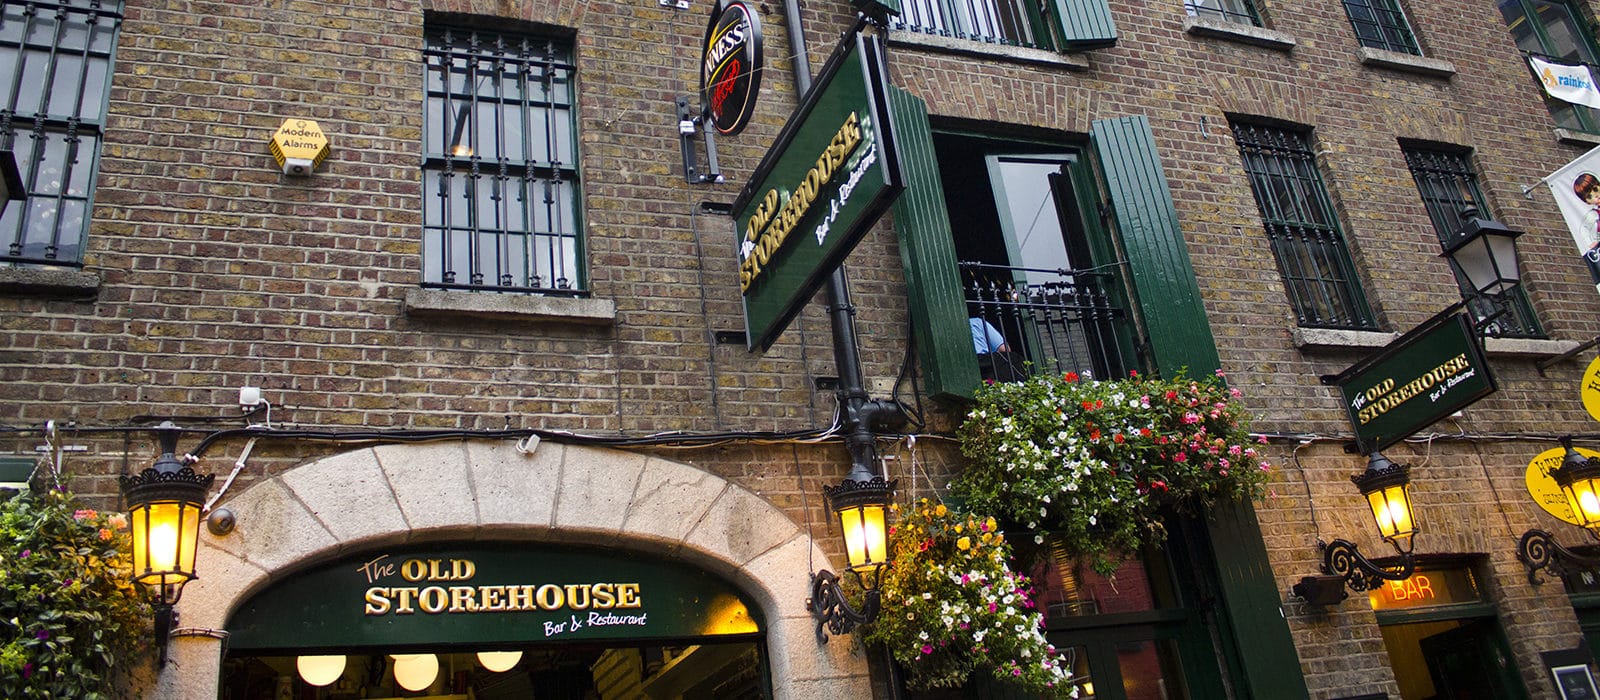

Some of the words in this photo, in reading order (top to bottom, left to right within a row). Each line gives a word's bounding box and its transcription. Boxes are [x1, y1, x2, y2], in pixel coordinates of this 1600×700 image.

[281, 127, 321, 138] Modern
[282, 140, 318, 150] Alarms
[740, 110, 862, 294] STOREHOUSE
[815, 215, 830, 247] Bar
[830, 198, 841, 223] &
[838, 143, 878, 207] Restaurant
[748, 188, 779, 242] OLD
[1351, 391, 1366, 411] The
[1365, 377, 1396, 402] OLD
[1357, 352, 1470, 426] STOREHOUSE
[1429, 389, 1441, 403] Bar
[1446, 367, 1476, 390] Restaurant
[356, 553, 397, 584] The
[401, 558, 477, 582] OLD
[364, 582, 642, 616] STOREHOUSE
[1389, 575, 1435, 600] BAR
[542, 620, 568, 637] Bar
[569, 614, 583, 633] &
[586, 611, 648, 627] Restaurant
